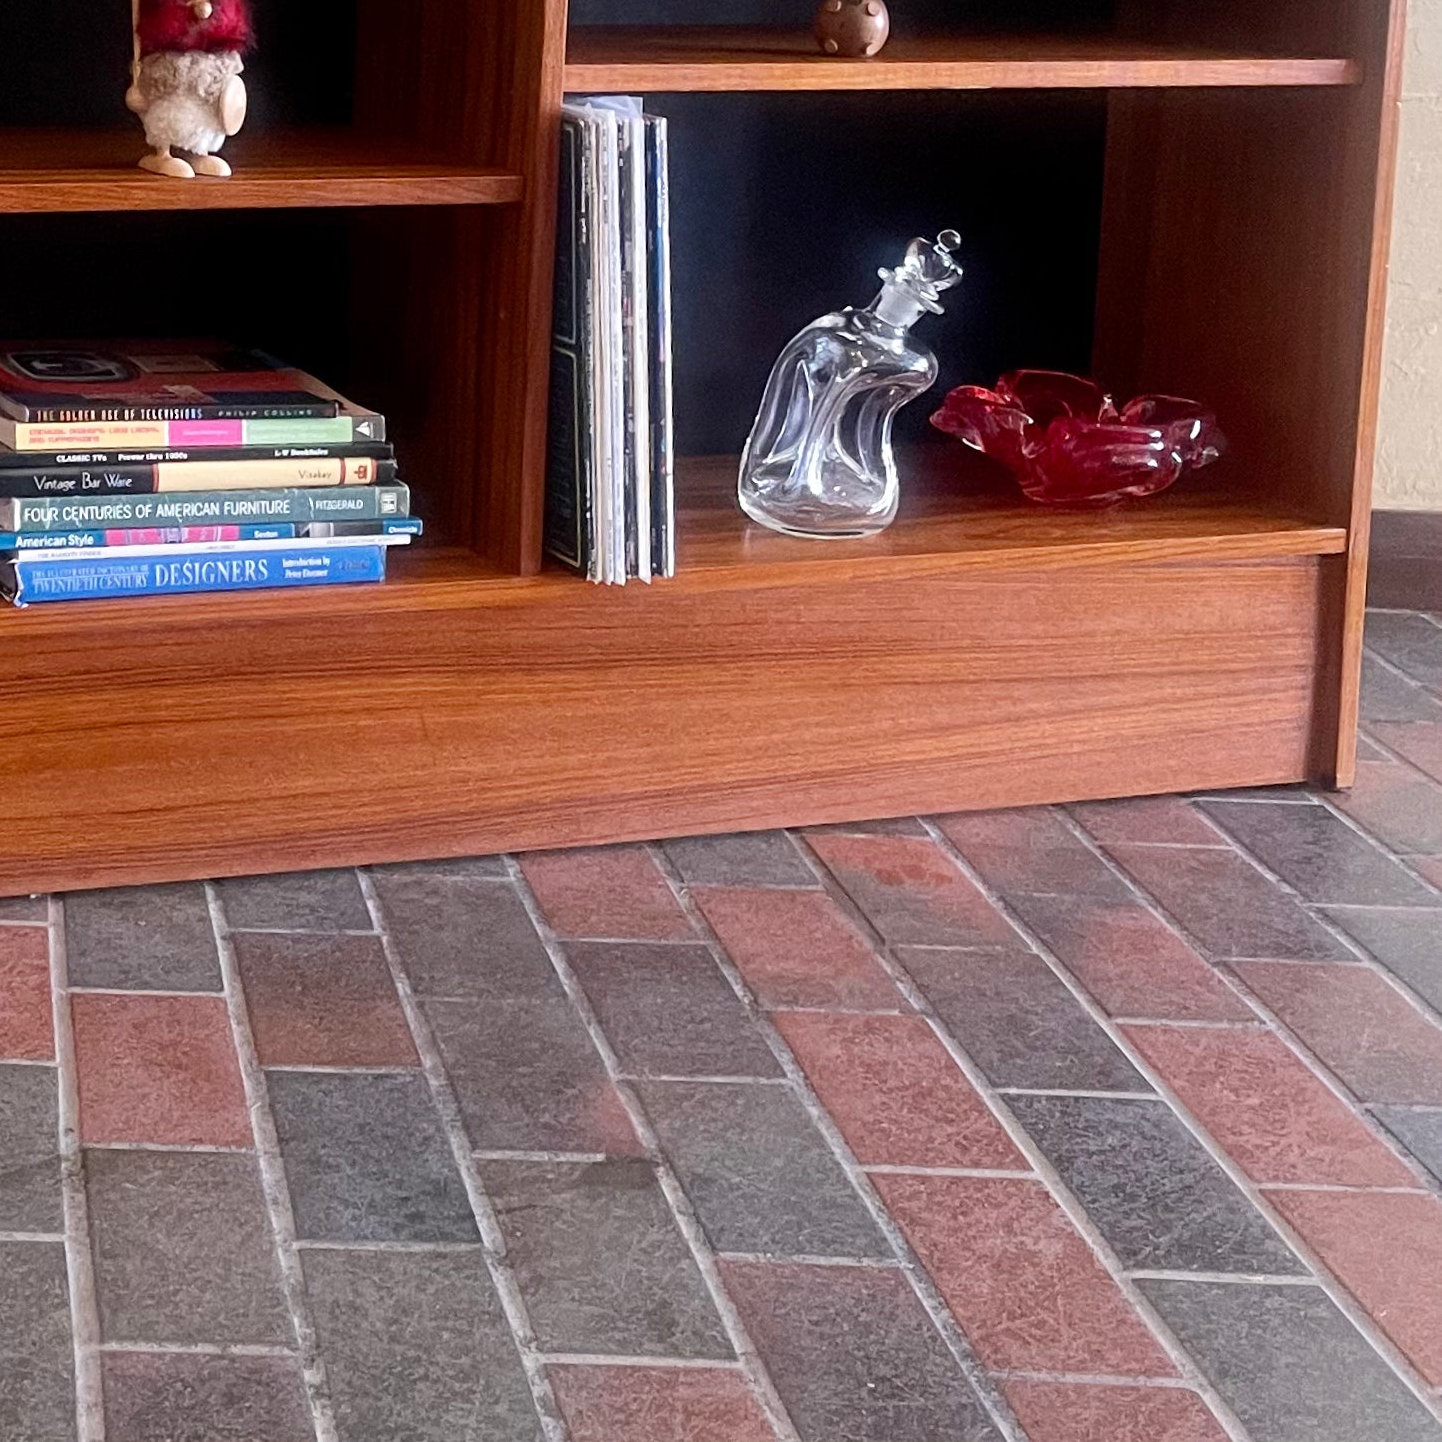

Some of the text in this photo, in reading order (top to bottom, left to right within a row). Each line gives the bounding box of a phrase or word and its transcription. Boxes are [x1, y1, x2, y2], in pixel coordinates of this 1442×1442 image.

[37, 409, 55, 423] THE
[124, 408, 135, 421] OF
[264, 409, 313, 417] COLLINS
[56, 454, 91, 463] CLASSIC
[34, 472, 133, 491] Vintage Bar Ware
[24, 499, 290, 523] FOUR CENTURIES OF AMERICAN FURNITURE
[315, 499, 364, 510] FITZGERALD
[15, 534, 95, 548] American Style
[155, 559, 268, 586] DESIGNERS
[34, 574, 148, 594] TWENTIETH CENTURY
